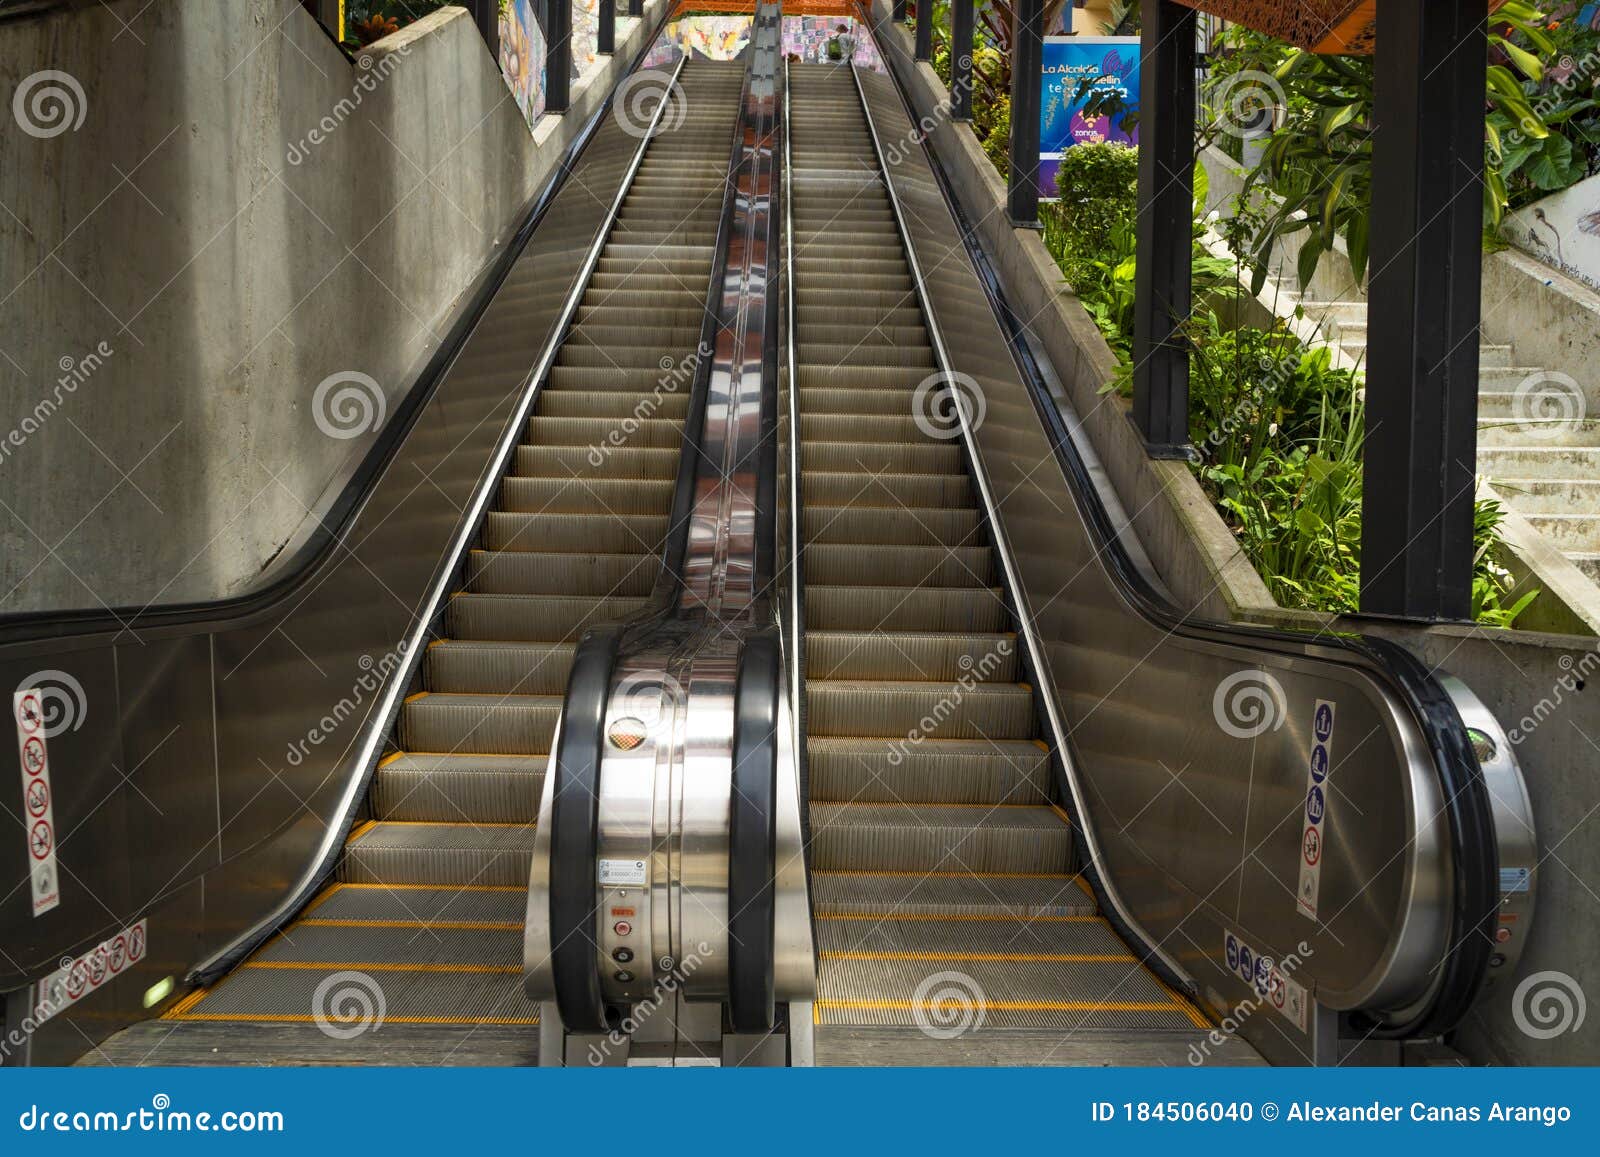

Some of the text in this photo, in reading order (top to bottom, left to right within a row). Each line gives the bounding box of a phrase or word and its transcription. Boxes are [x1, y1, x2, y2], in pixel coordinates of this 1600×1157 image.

[1041, 63, 1056, 74] La
[1048, 84, 1128, 98] te coecta
